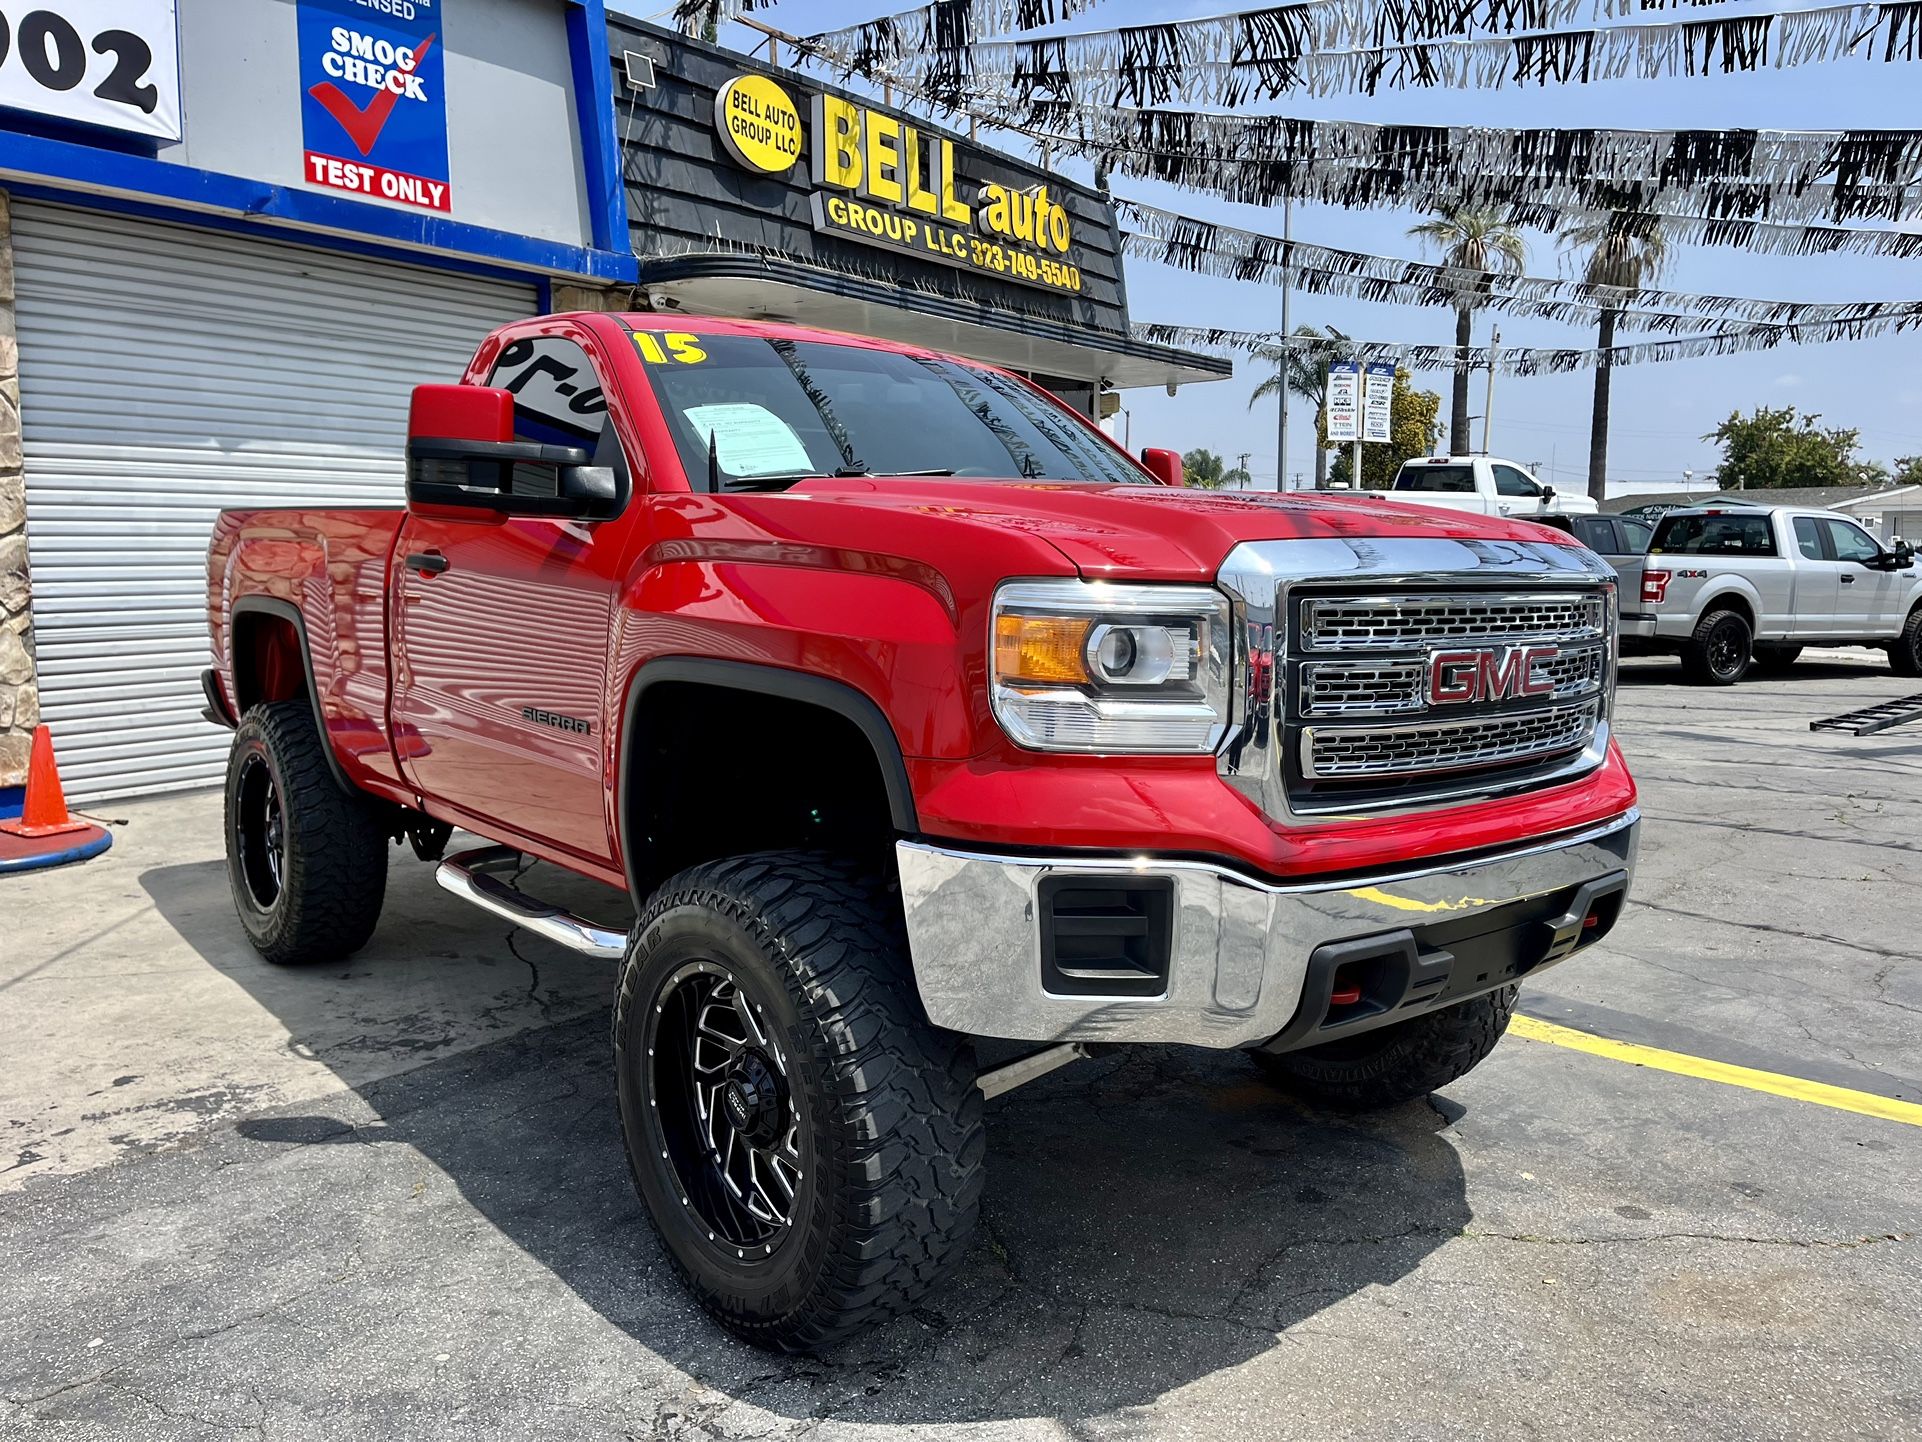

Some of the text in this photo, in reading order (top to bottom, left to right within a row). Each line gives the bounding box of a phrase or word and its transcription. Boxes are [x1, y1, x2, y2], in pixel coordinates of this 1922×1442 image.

[0, 10, 158, 114] 02
[331, 26, 416, 72] SMOG
[321, 51, 428, 102] CHECK
[732, 89, 796, 132] BELL AUTO
[731, 117, 796, 156] GROUP LLC
[310, 155, 444, 207] TEST ONLY
[823, 92, 1071, 255] BELL auto
[828, 197, 1082, 291] GROUP LLC 323-749-5540
[632, 332, 709, 365] 15
[1428, 645, 1559, 705] GMC
[521, 706, 591, 735] SIERRA
